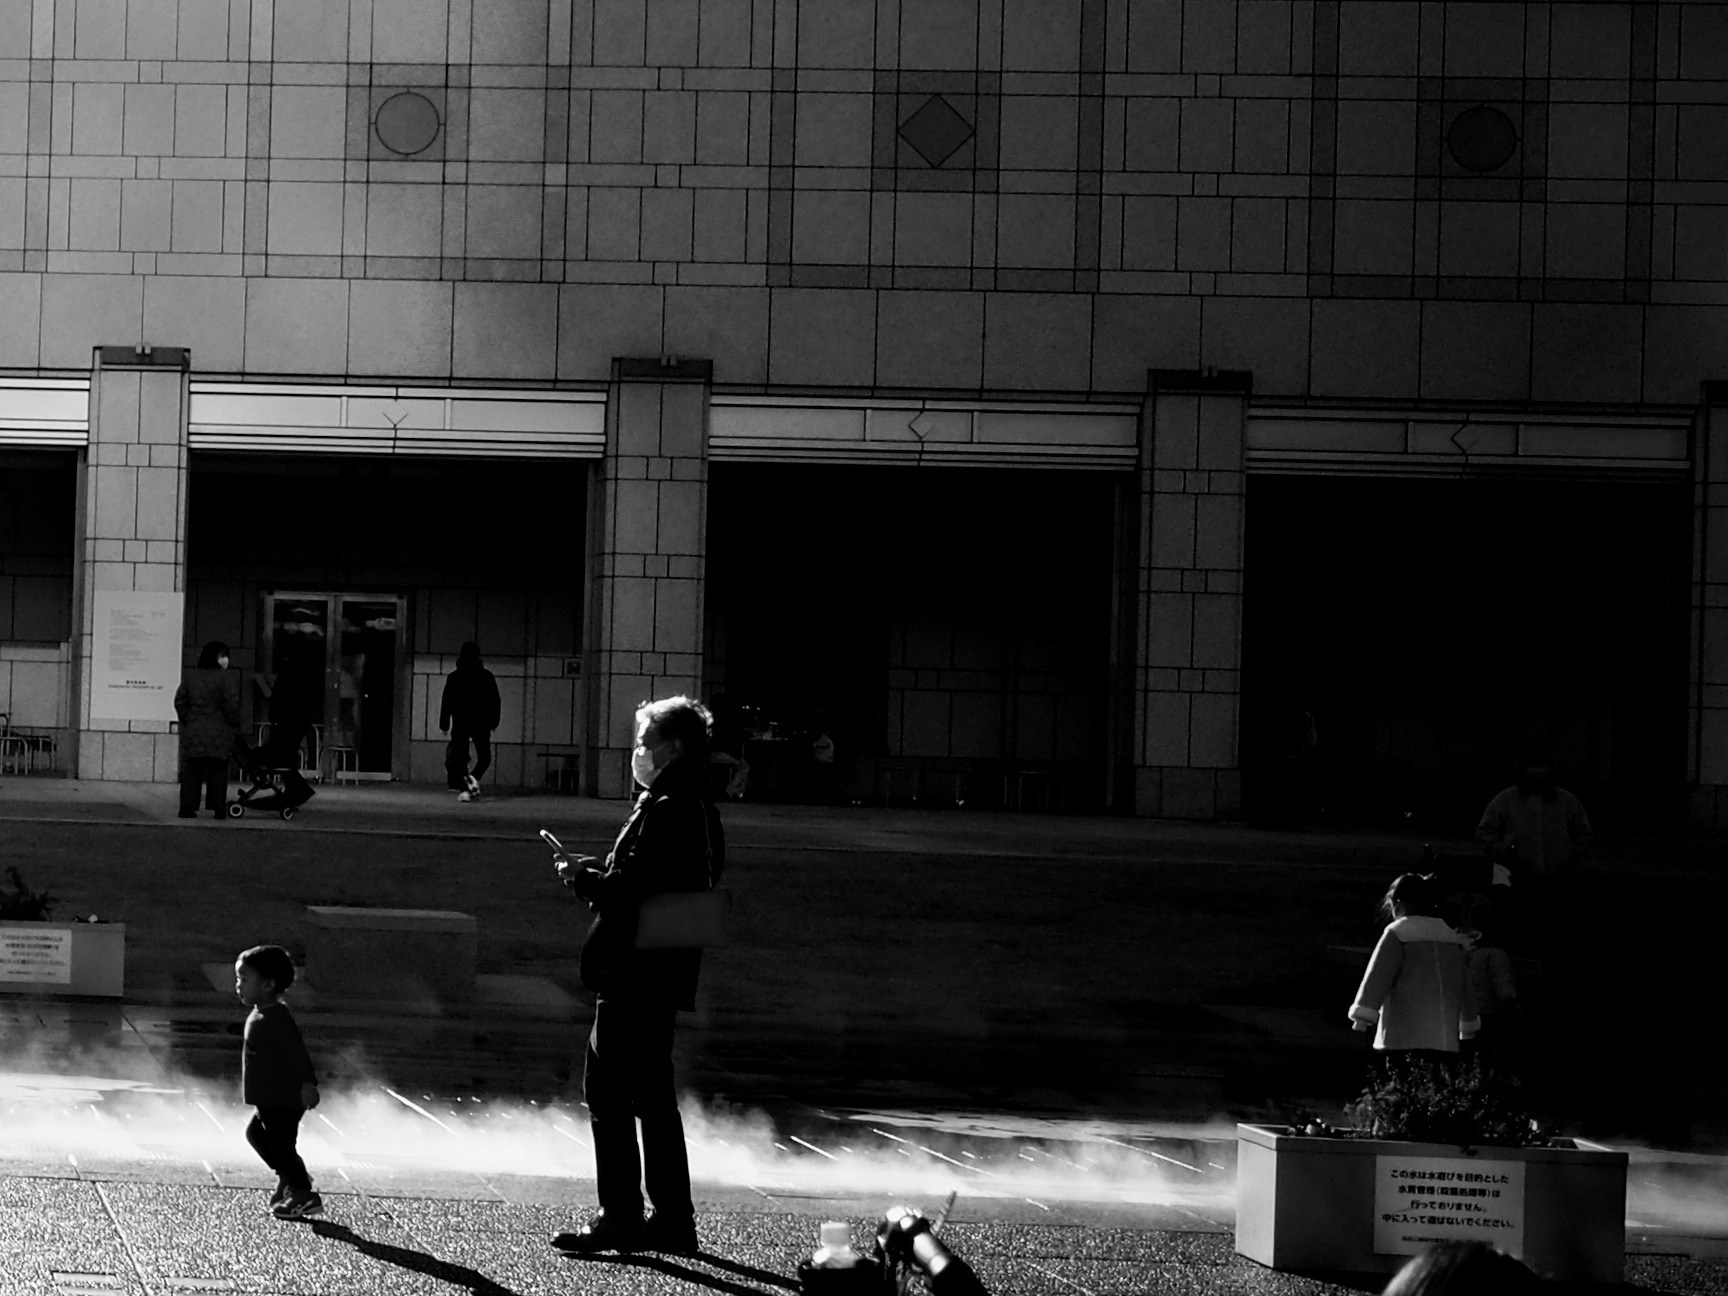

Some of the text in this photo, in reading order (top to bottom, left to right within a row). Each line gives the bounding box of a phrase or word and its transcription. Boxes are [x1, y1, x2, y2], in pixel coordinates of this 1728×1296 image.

[1390, 1169, 1510, 1184] この水は水遊びを目的とした
[1410, 1199, 1487, 1213] 行っておりません。
[1382, 1213, 1515, 1229] 中に入って遊ばないでください。
